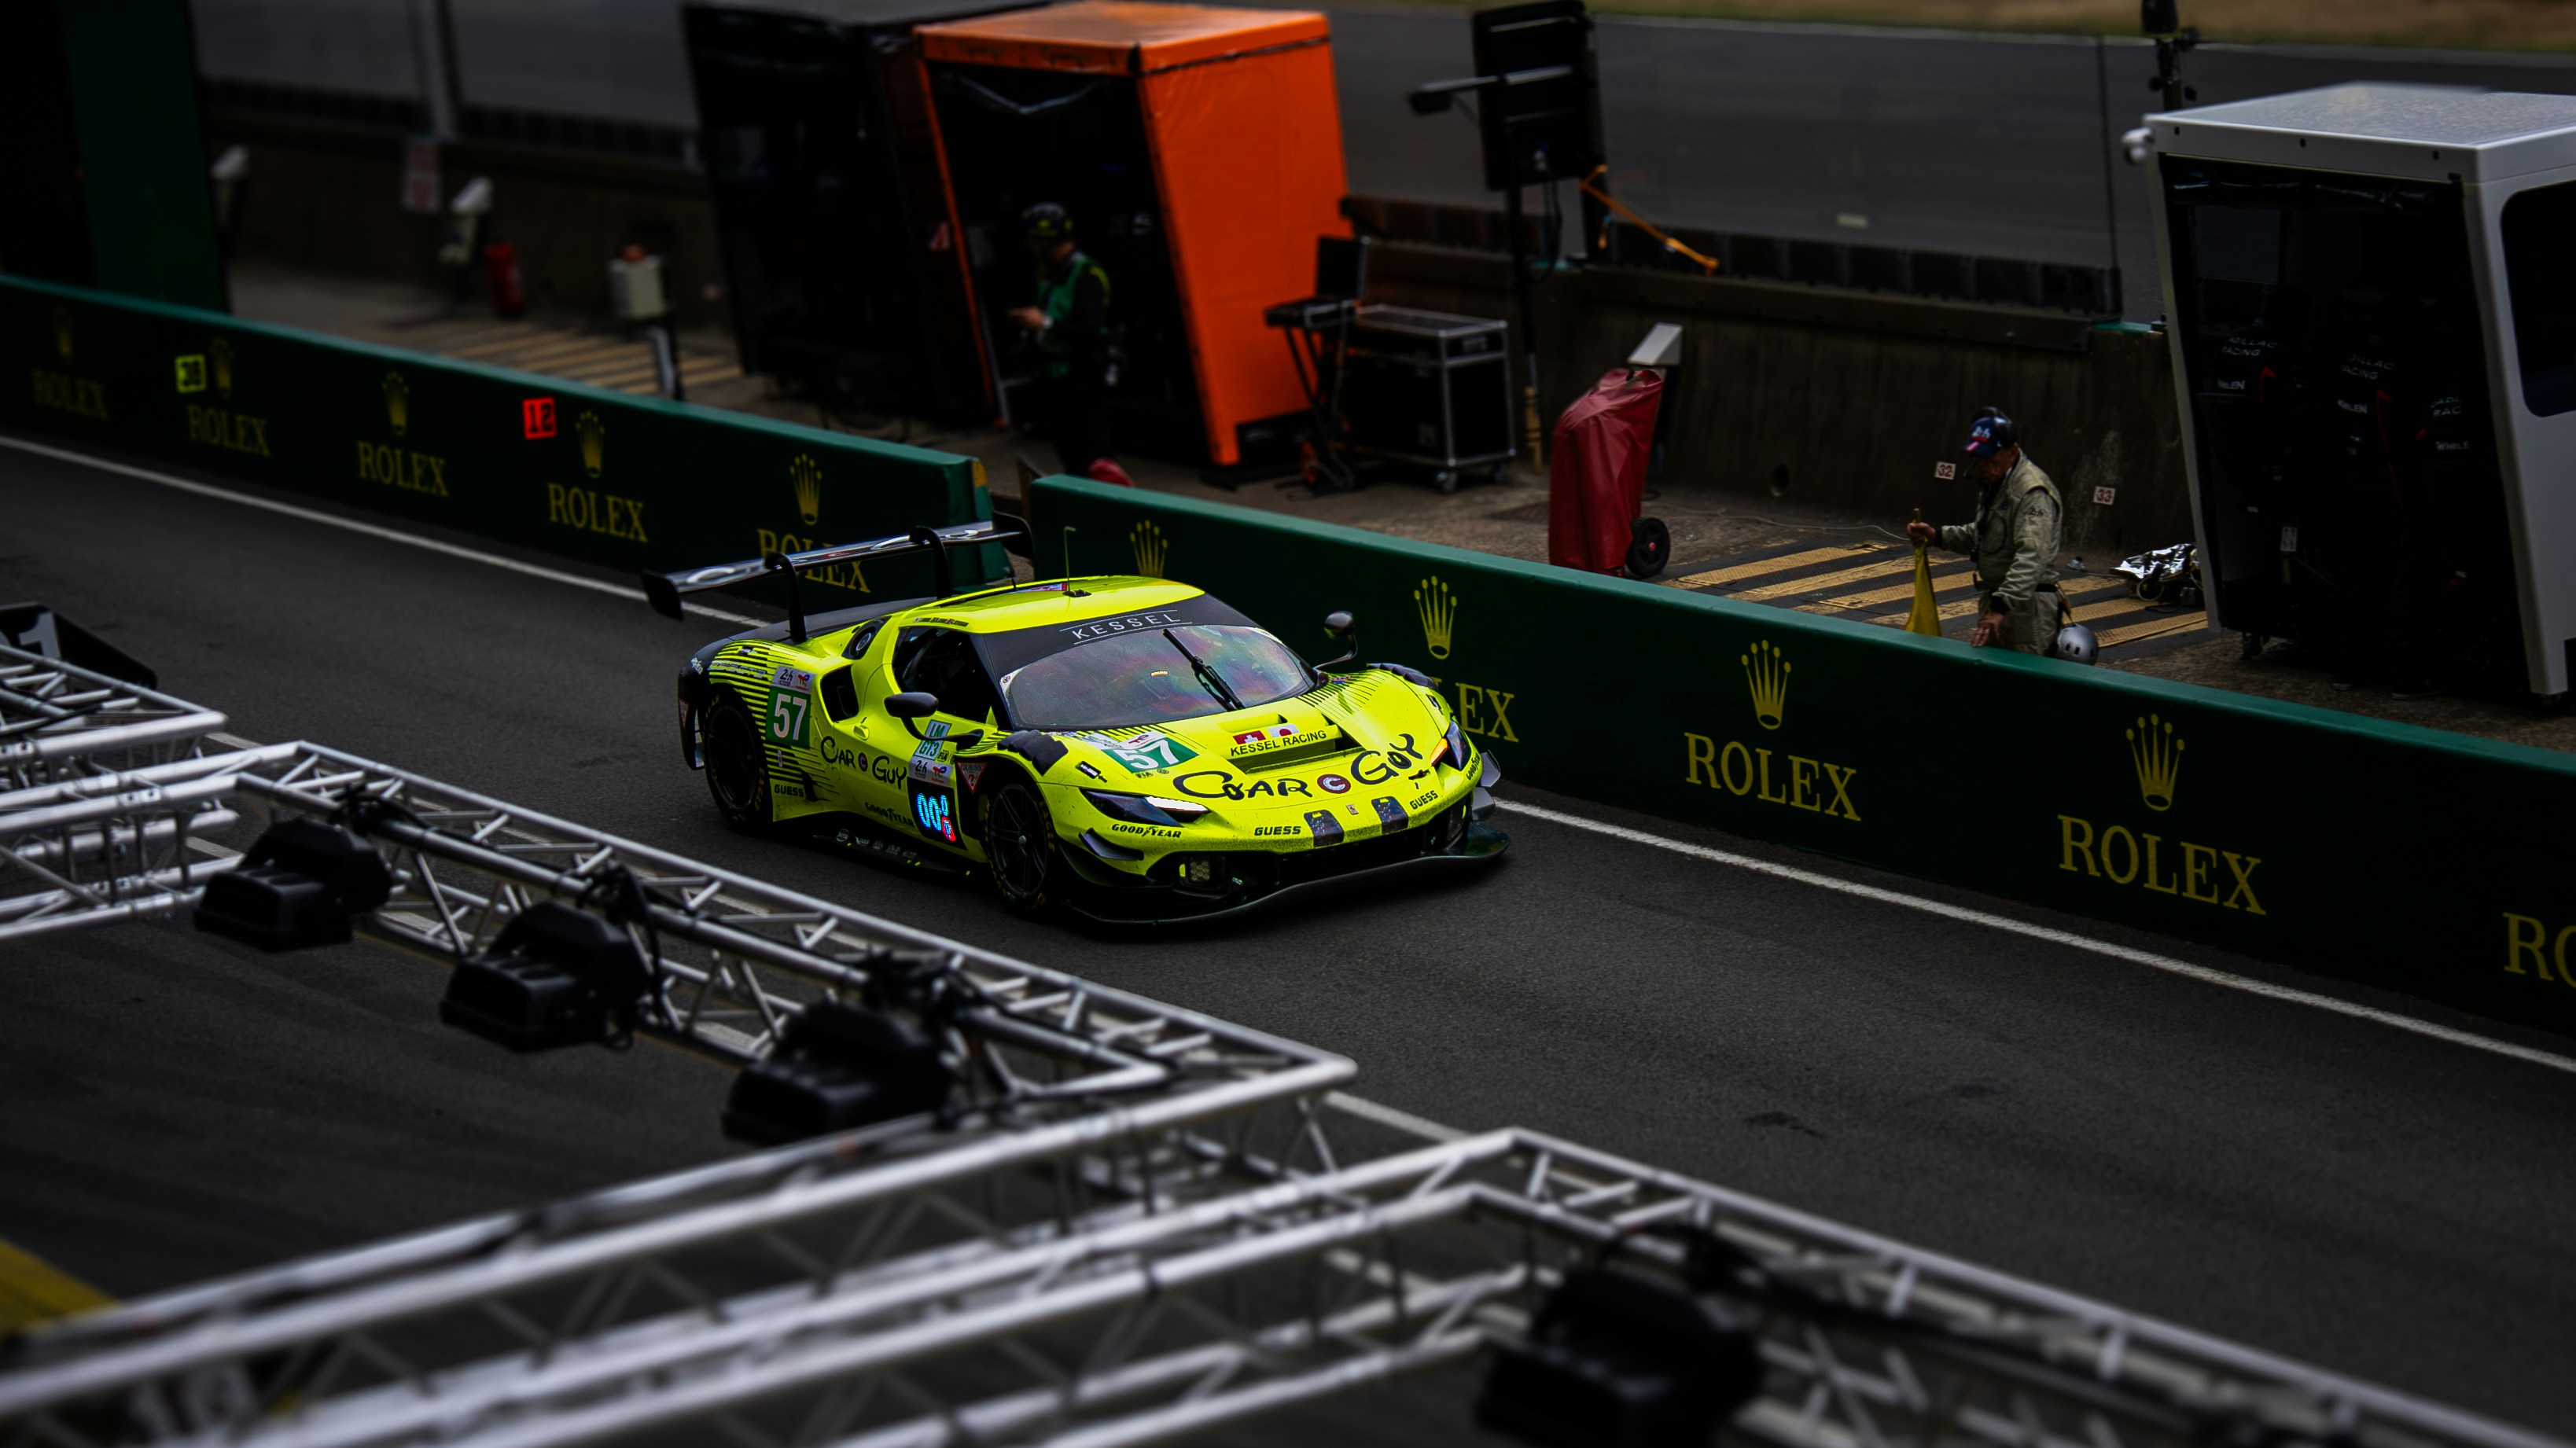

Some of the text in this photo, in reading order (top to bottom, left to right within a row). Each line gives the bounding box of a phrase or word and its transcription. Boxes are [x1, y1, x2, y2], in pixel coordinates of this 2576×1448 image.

[31, 367, 110, 421] ROLEX
[186, 402, 271, 458] ROLEX
[356, 439, 451, 498] ROLEX
[1938, 465, 1952, 477] 32
[2097, 489, 2112, 502] 33
[546, 481, 650, 544] ROLEX
[1072, 613, 1180, 640] KESSEL
[773, 693, 808, 741] 57
[929, 723, 946, 737] LM
[918, 740, 940, 757] GT3
[1113, 739, 1179, 770] 57
[1230, 730, 1327, 757] KESSEL RACING
[821, 736, 856, 770] CAR
[872, 755, 907, 790] GUY
[1684, 731, 1861, 821] ROLEX
[774, 784, 804, 797] GUESS
[1410, 789, 1439, 810] GUESS
[865, 802, 914, 827] GOODYEAR
[1111, 823, 1182, 838] GOODYEAR
[1253, 825, 1301, 836] GUESS
[2057, 814, 2268, 917] ROLEX
